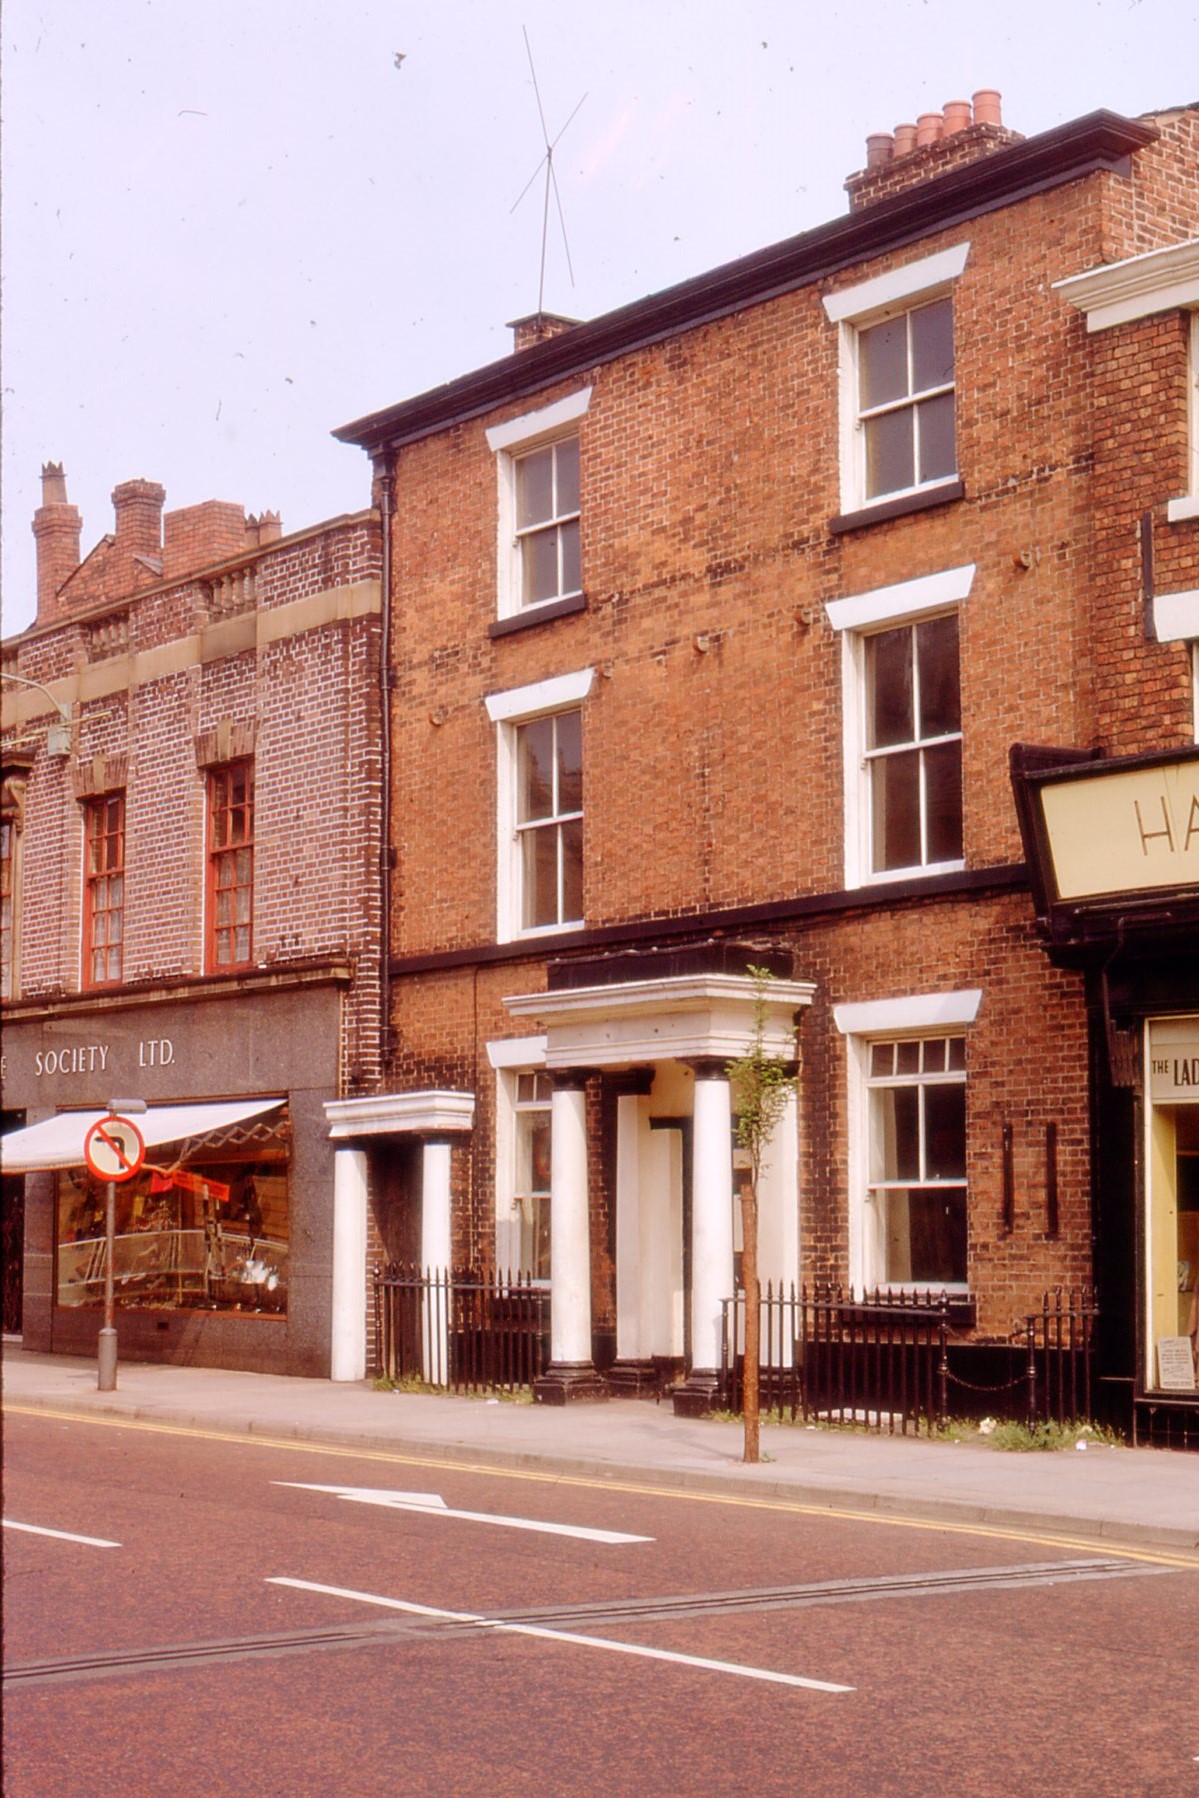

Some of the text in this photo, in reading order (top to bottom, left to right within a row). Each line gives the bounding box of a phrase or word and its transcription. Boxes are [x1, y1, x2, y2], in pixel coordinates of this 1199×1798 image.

[35, 1045, 109, 1076] SOCIETY
[139, 1039, 175, 1067] LTD.
[1151, 1060, 1169, 1074] THE
